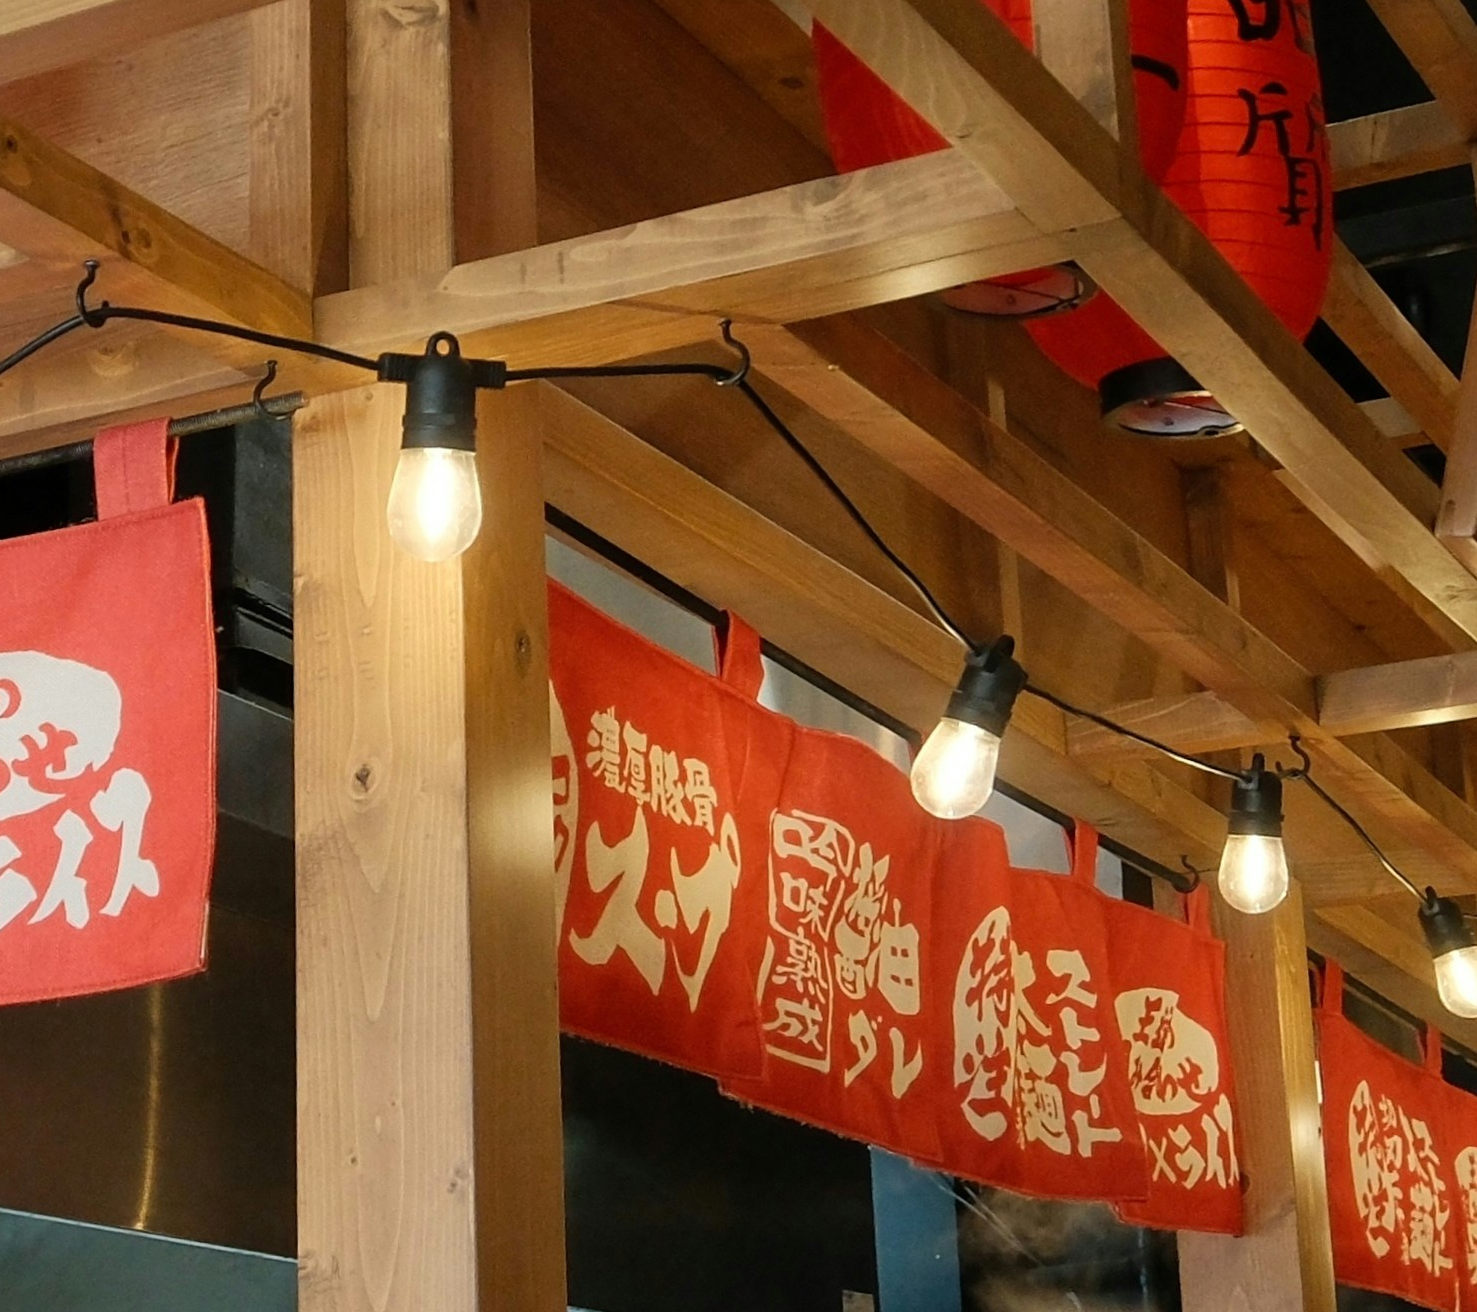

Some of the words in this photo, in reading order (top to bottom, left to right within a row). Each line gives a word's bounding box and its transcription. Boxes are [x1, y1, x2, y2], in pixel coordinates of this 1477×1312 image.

[585, 705, 719, 837] 濃厚豚骨
[568, 804, 742, 1014] スープ
[763, 812, 854, 1055] 吟味熟成
[1044, 948, 1124, 1158] ストレート
